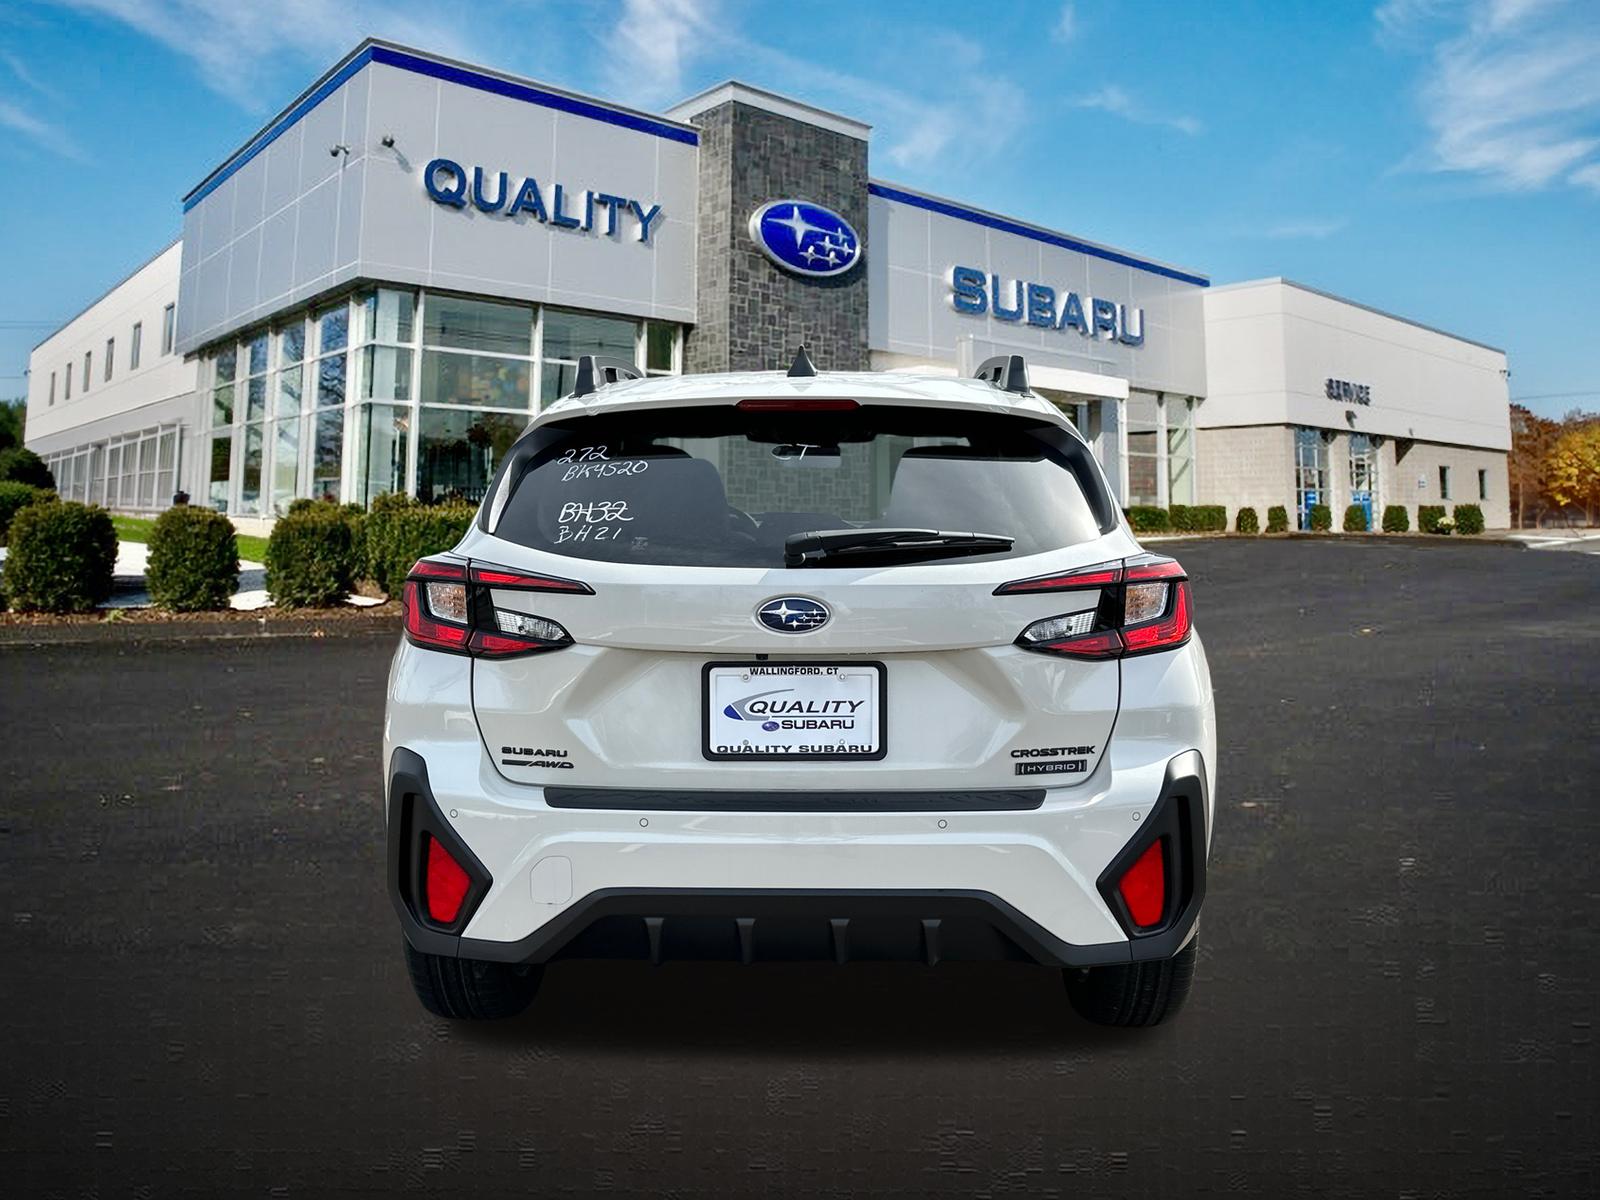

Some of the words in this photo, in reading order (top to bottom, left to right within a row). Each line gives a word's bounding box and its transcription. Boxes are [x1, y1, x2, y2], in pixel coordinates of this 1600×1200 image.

[424, 158, 662, 243] QUALITY
[952, 265, 1145, 347] SUBARU
[557, 445, 610, 465] 272
[749, 667, 824, 676] WALLINGFORD,
[826, 667, 839, 675] CT
[749, 700, 864, 714] QUALITY
[781, 719, 855, 730] SUBARU
[501, 746, 568, 758] SUBARU
[716, 745, 792, 753] QUALITY
[798, 745, 872, 753] SUBARU
[1010, 745, 1096, 758] CROSSTREK
[528, 760, 575, 769] AWD
[1027, 763, 1076, 772] HYBRID
